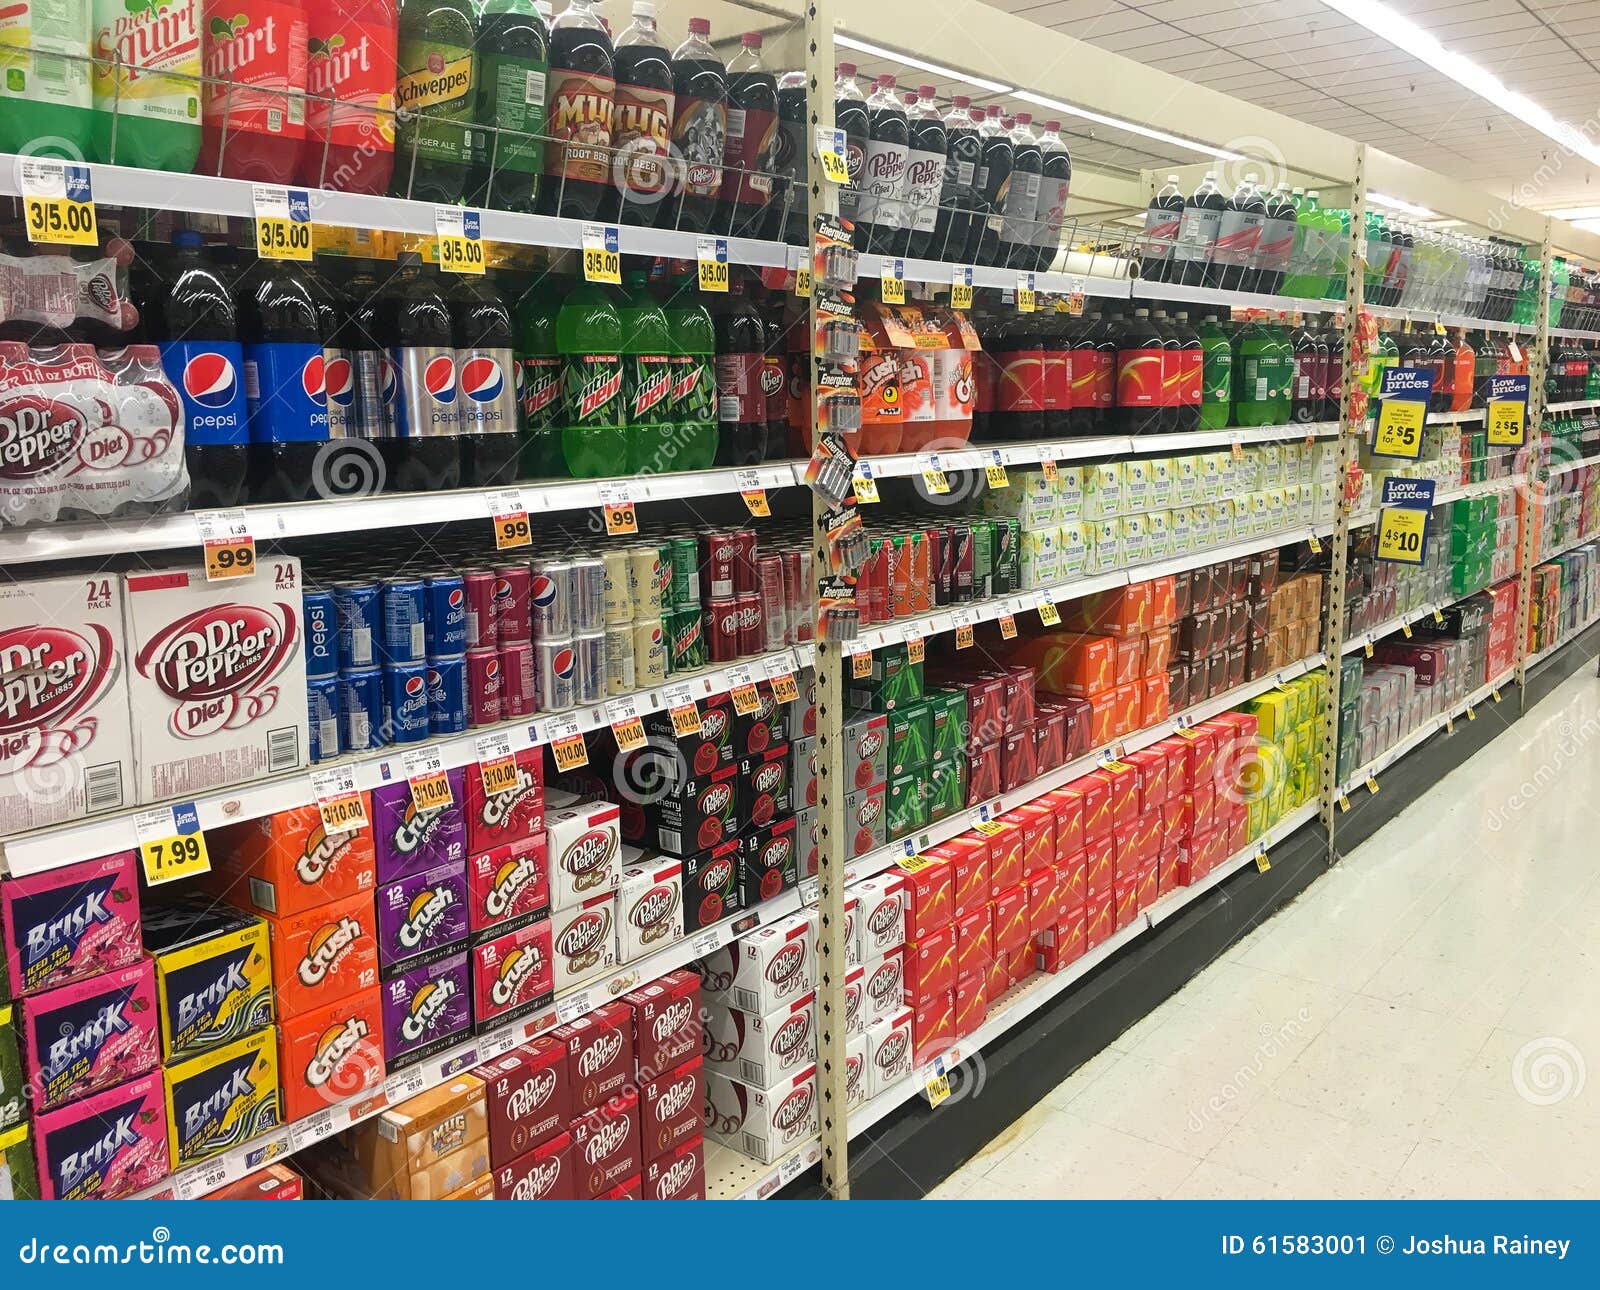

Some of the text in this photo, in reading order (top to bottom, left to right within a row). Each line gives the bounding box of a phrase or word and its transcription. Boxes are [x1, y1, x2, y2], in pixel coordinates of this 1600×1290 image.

[114, 12, 150, 34] Diet
[96, 0, 196, 81] Squirt
[397, 71, 467, 108] Schweppes
[440, 142, 457, 150] ALE
[568, 149, 591, 160] ROOT
[67, 182, 89, 191] price
[69, 176, 87, 184] Low
[290, 205, 308, 213] price
[291, 198, 306, 207] Low
[30, 202, 92, 232] 3/5.00
[261, 222, 309, 249] 3/5.00
[820, 222, 851, 243] Energizer
[443, 240, 481, 263] 3/5.00
[586, 251, 618, 275] 3/5.00
[700, 263, 727, 283] 3/5.00
[820, 298, 851, 316] Energizer
[820, 373, 852, 388] Energizer
[1387, 370, 1416, 381] Low
[1492, 378, 1515, 388] Low
[1386, 380, 1429, 392] prices
[1492, 385, 1526, 397] prices
[18, 408, 52, 435] Dr
[193, 412, 237, 430] pepsi
[467, 409, 503, 424] pepsi
[1495, 421, 1501, 429] 2
[1382, 435, 1394, 444] for
[1386, 426, 1393, 435] 2
[91, 436, 123, 462] Diet
[822, 435, 853, 467] Energizer
[1388, 481, 1418, 492] Low
[1387, 490, 1430, 503] prices
[609, 511, 634, 527] .99
[828, 506, 857, 529] Energizer
[499, 521, 528, 540] .99
[1385, 529, 1391, 540] 4
[1382, 541, 1392, 549] for
[210, 548, 253, 570] .99
[274, 563, 295, 583] 24
[86, 580, 112, 602] 24
[275, 582, 295, 590] PACK
[823, 586, 853, 599] Energizer
[87, 600, 112, 609] PACK
[203, 616, 246, 651] Dr
[307, 606, 330, 657] pepsi
[165, 626, 272, 693] Pepper
[774, 681, 796, 696] 4/5.00
[187, 695, 225, 730] Diet
[673, 711, 698, 725] 3/10.00
[616, 727, 644, 744] 3/10.00
[497, 745, 510, 755] 3.99
[555, 748, 585, 764] 3/10.00
[427, 760, 441, 770] 3.99
[338, 780, 353, 791] 3.99
[484, 766, 517, 787] 3/10.00
[412, 779, 449, 802] 3/10.00
[687, 781, 697, 794] 12
[323, 801, 362, 825] 3/10.00
[655, 797, 682, 811] cherry
[150, 837, 200, 870] 7.99
[570, 838, 608, 868] Pepper
[582, 836, 598, 855] Dr
[328, 842, 352, 874] Orange
[476, 856, 491, 871] 12
[356, 870, 372, 886] 12
[487, 857, 535, 916] Crush
[505, 873, 537, 917] Strawberry
[399, 886, 453, 948] Crush
[426, 912, 445, 938] Grape
[118, 948, 132, 959] 12
[298, 917, 362, 986] Crush
[330, 942, 354, 974] Orange
[781, 950, 796, 967] Dr
[27, 945, 68, 977] ICED TEA
[38, 954, 71, 977] HELADO
[773, 955, 803, 978] Pepper
[358, 967, 375, 985] 12
[252, 1008, 264, 1020] 12
[594, 1034, 613, 1060] Dr
[579, 1038, 622, 1077] Pepper
[495, 1078, 510, 1092] 12
[523, 1077, 546, 1105] Dr
[599, 1076, 626, 1094] PLAYOFF
[507, 1080, 556, 1121] Pepper
[530, 1117, 560, 1138] PLAYOFF
